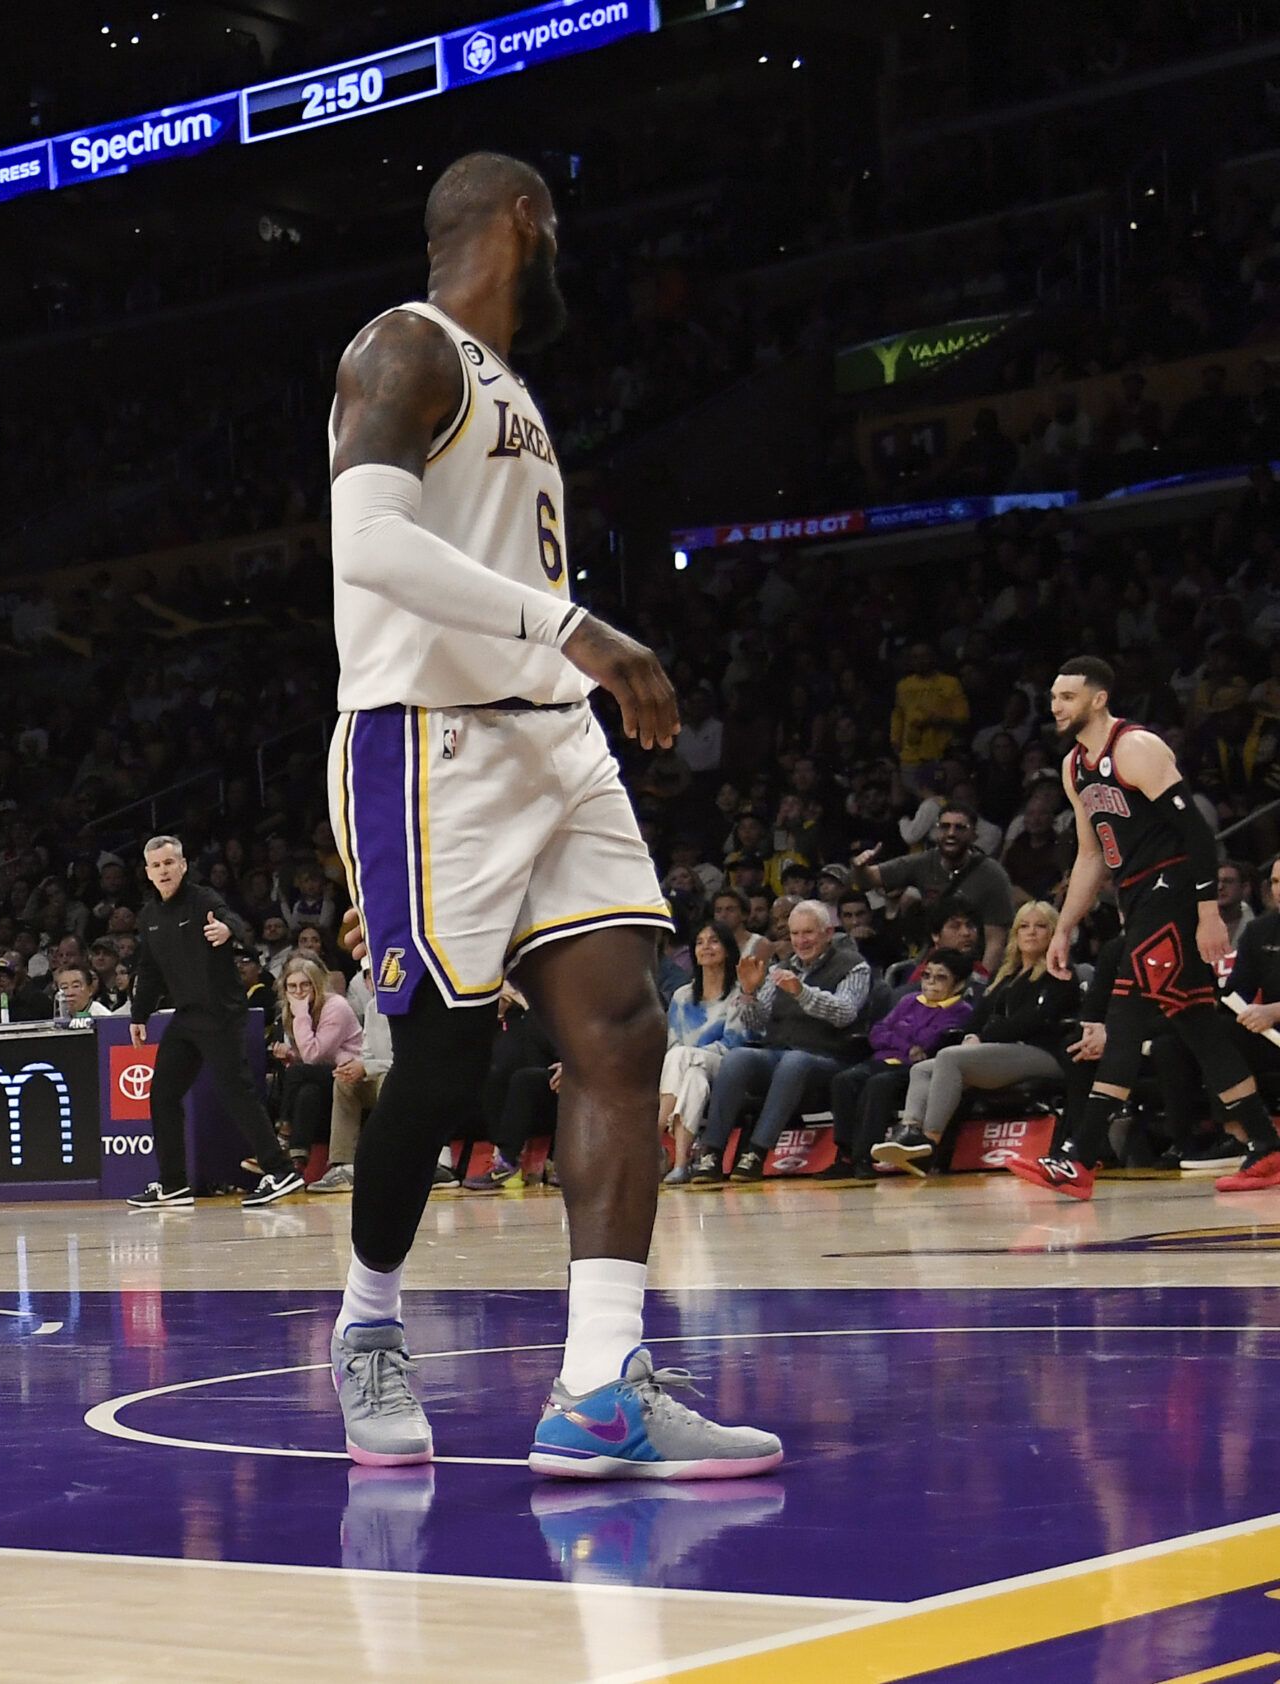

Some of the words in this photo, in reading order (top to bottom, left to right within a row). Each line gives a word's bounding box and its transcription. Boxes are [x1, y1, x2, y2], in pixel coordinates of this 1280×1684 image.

[499, 2, 628, 53] crypto.com
[301, 67, 384, 119] 2:50
[70, 112, 214, 174] Spectrum
[536, 491, 564, 590] 6
[101, 1136, 154, 1155] TOYO
